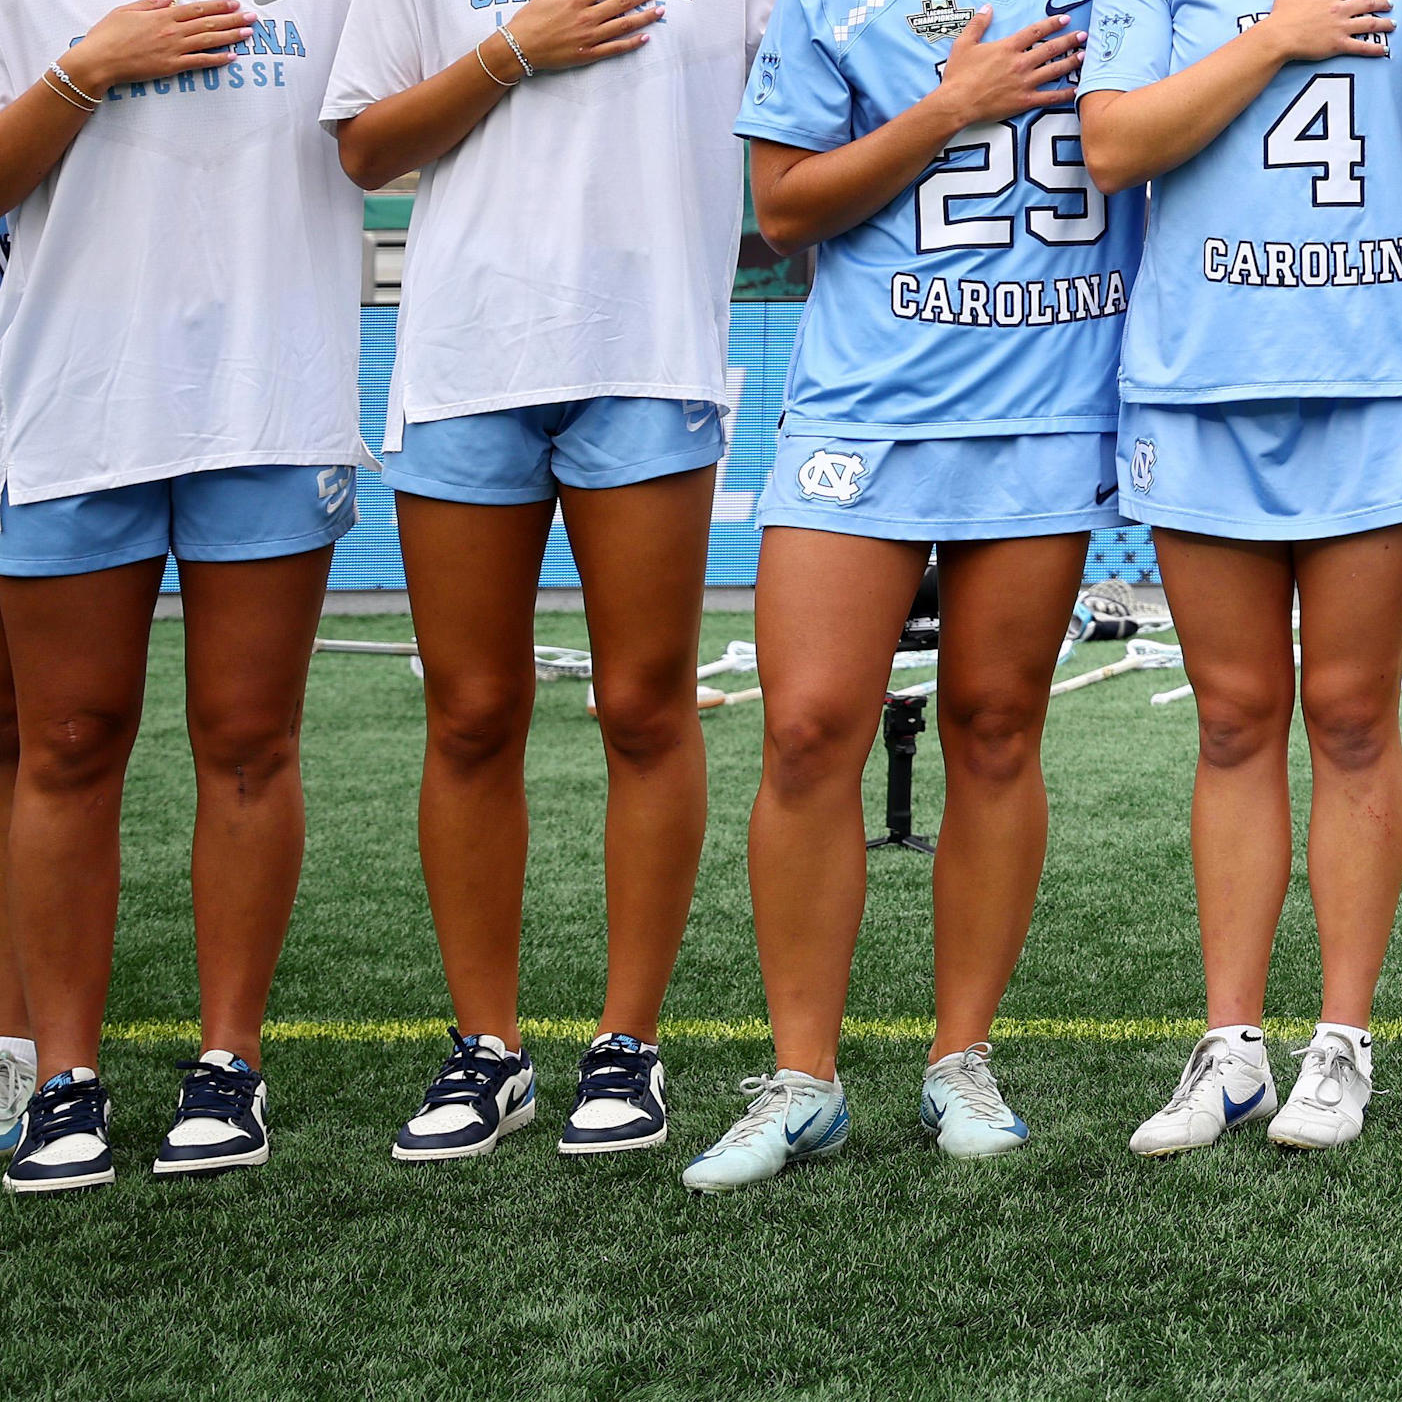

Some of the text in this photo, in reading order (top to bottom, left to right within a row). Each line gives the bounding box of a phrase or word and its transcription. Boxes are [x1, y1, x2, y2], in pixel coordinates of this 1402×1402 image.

[915, 108, 1108, 255] 29
[1263, 73, 1366, 208] 4
[890, 270, 1128, 329] CAROLINA
